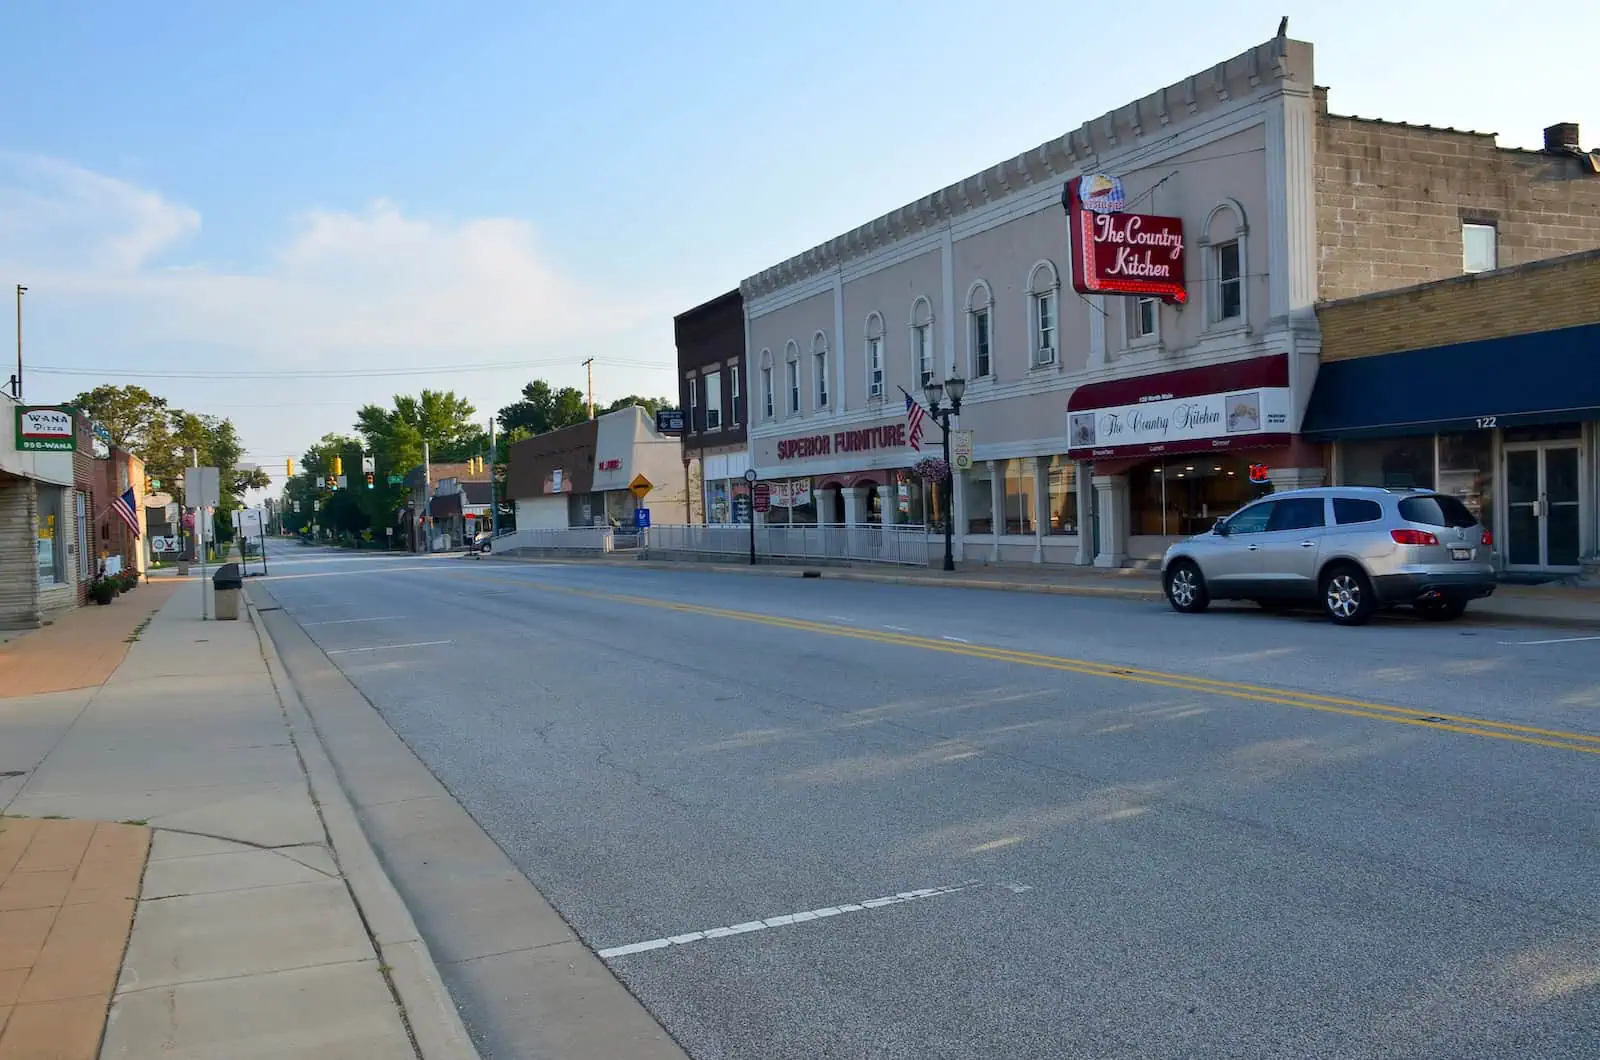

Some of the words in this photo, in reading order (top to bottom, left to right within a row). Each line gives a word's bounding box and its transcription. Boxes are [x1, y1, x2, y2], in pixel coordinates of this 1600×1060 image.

[1094, 214, 1124, 243] The
[1126, 215, 1184, 260] Country
[1105, 246, 1170, 277] Kitchen
[28, 414, 68, 423] WANA
[1099, 413, 1123, 437] The
[1126, 408, 1169, 437] Country
[1172, 403, 1220, 430] Kitchen
[1475, 416, 1497, 429] 122
[777, 434, 831, 460] SUPERIOR
[834, 423, 906, 454] FURNITURE
